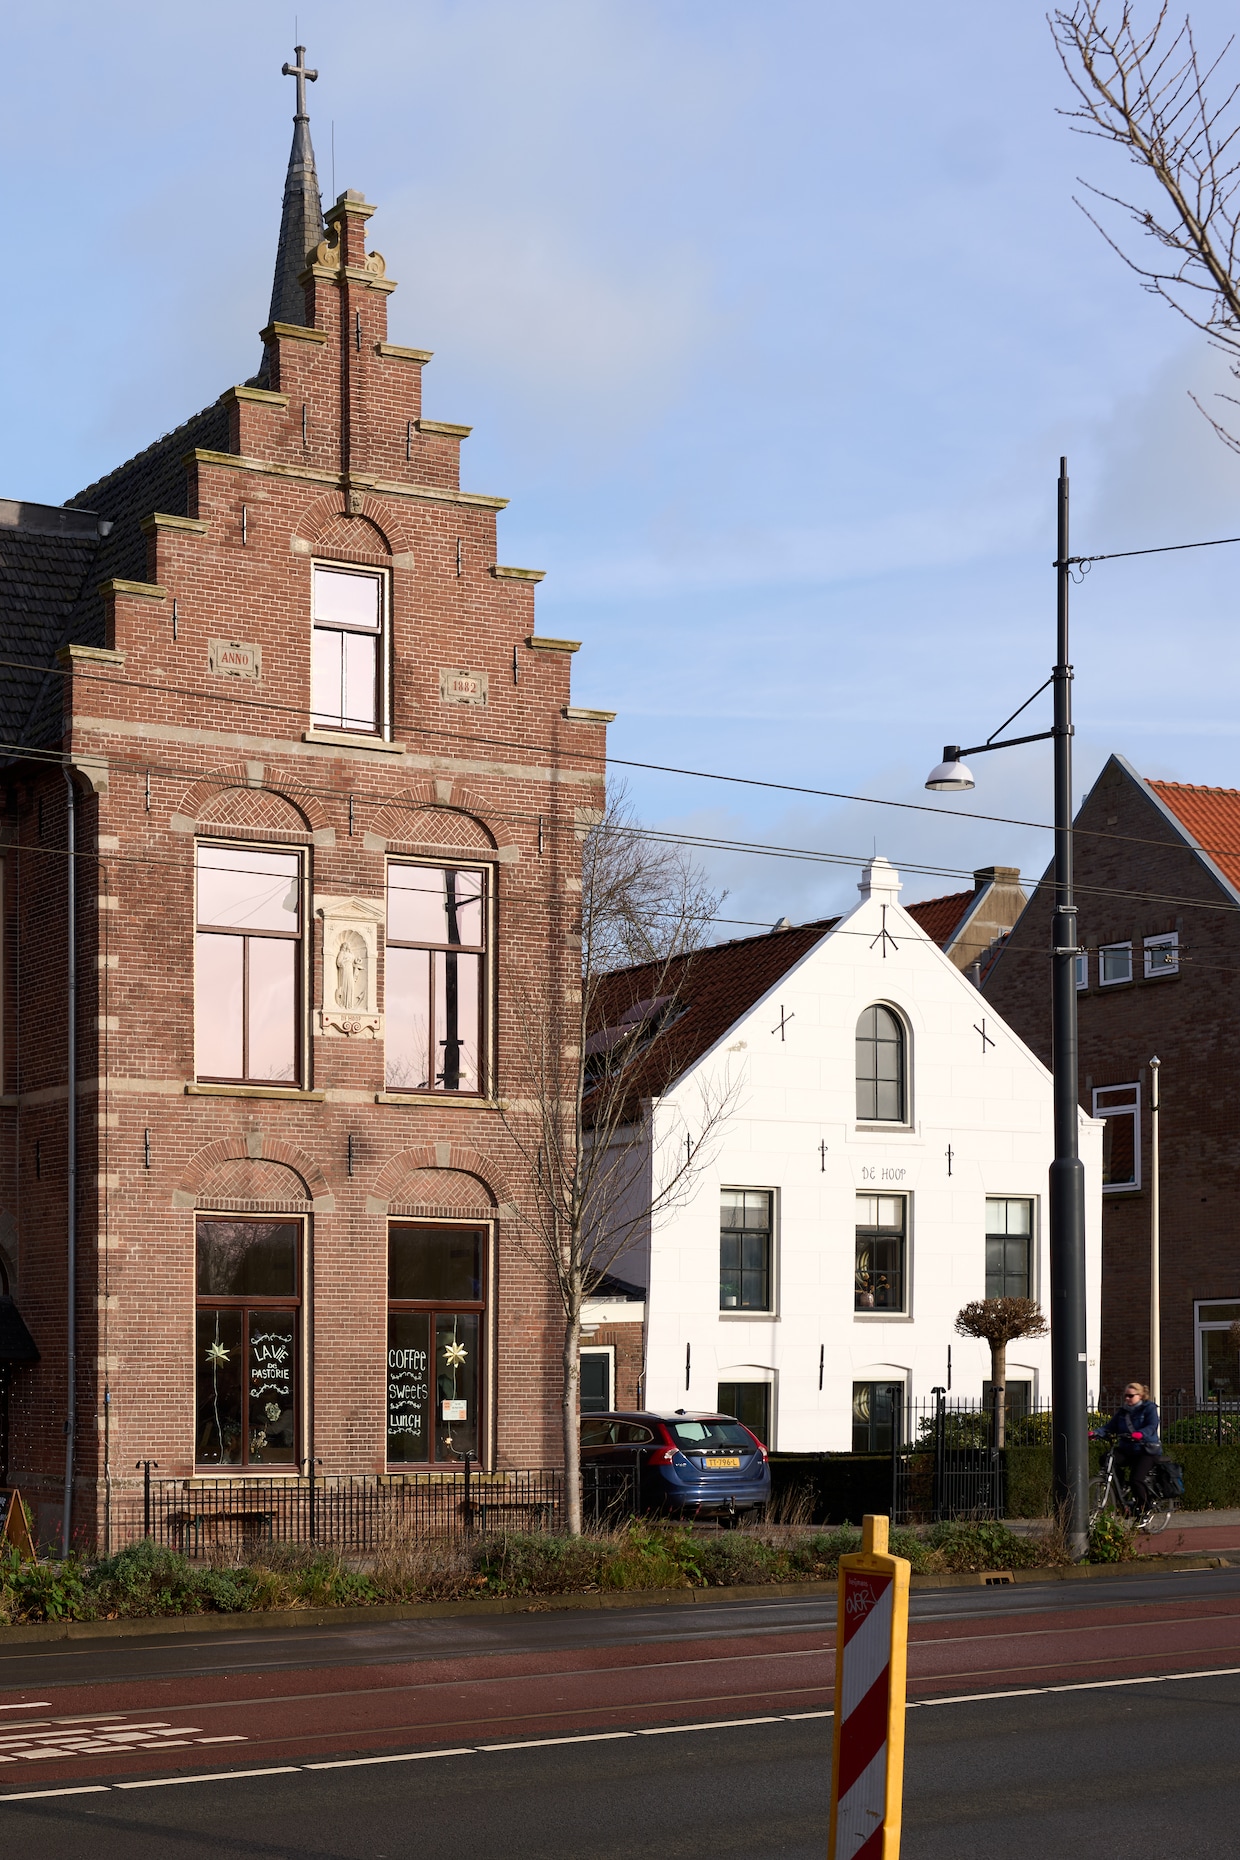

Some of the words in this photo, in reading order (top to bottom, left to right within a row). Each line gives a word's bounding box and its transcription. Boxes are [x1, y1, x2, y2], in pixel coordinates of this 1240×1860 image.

[221, 652, 249, 666] ANNO
[453, 680, 477, 693] 1882
[862, 1166, 876, 1179] DE
[881, 1168, 907, 1180] HOOP
[254, 1345, 272, 1362] LA
[251, 1369, 290, 1380] PASTORIE
